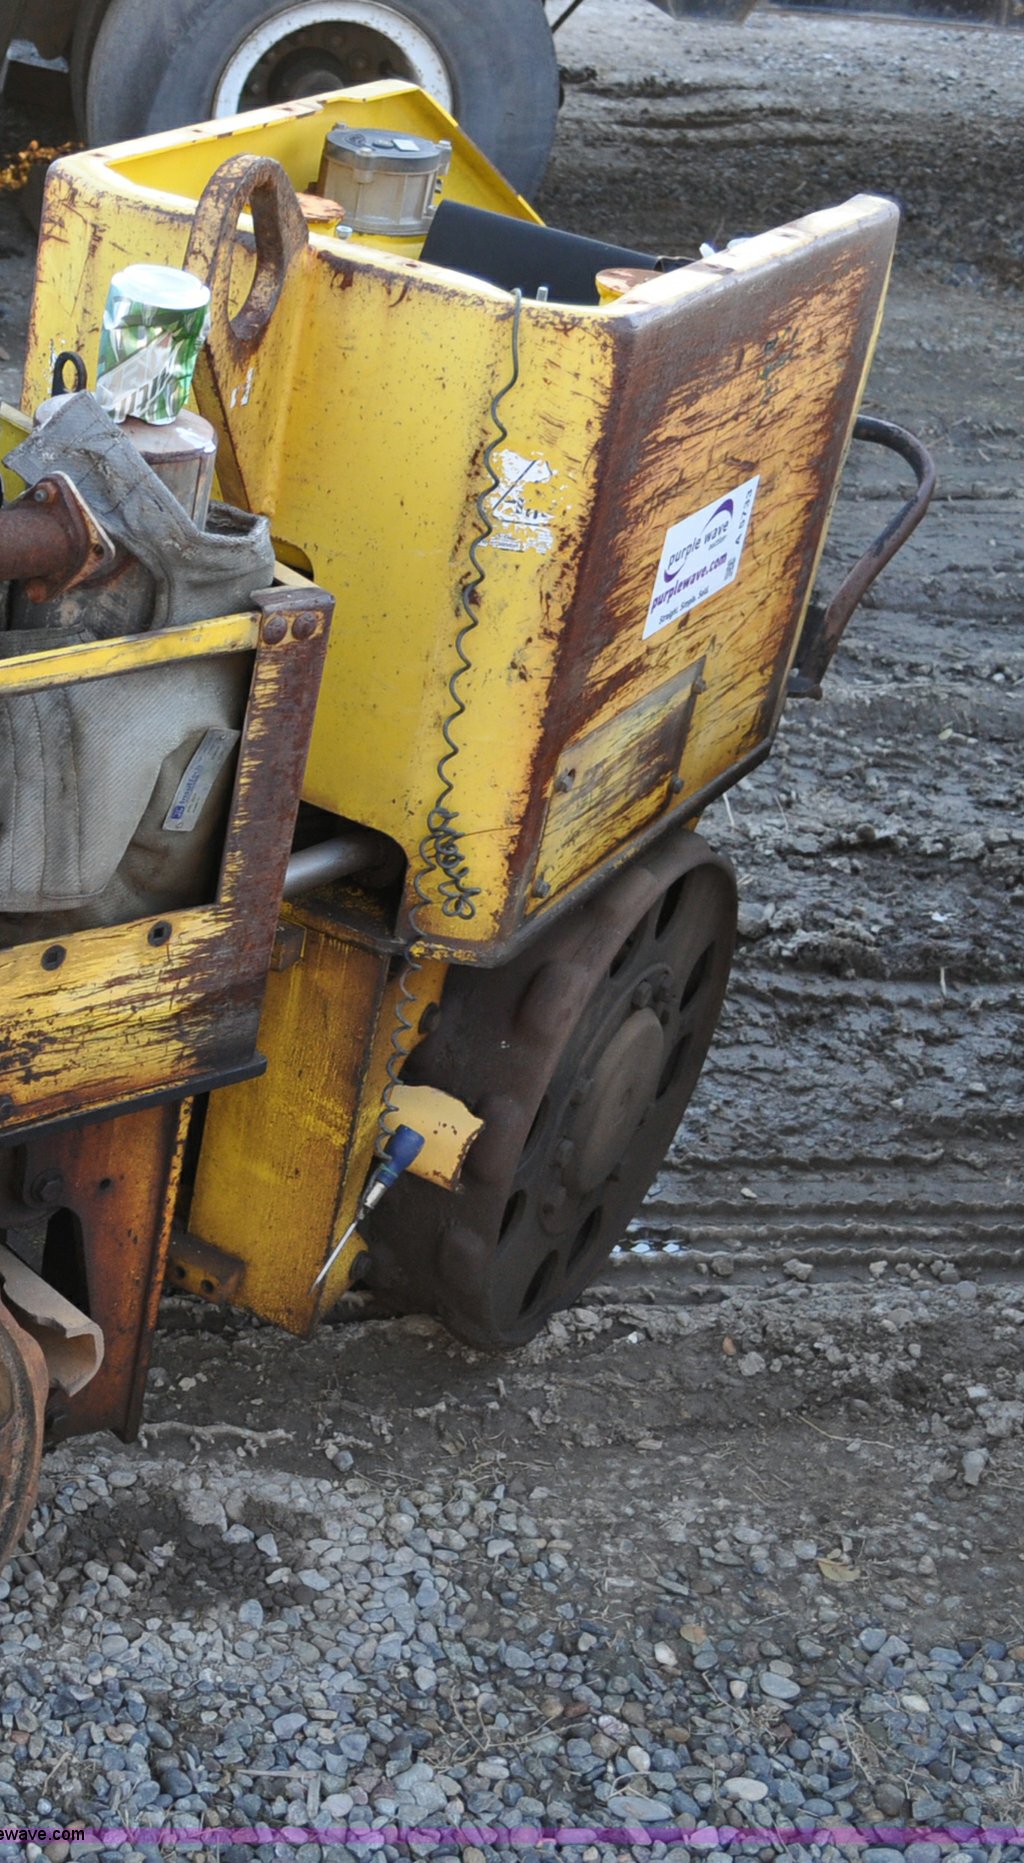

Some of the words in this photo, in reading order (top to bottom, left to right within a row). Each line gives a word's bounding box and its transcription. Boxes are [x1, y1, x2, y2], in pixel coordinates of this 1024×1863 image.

[668, 534, 701, 571] purple
[704, 520, 729, 544] wave
[650, 553, 728, 614] purplewave.com
